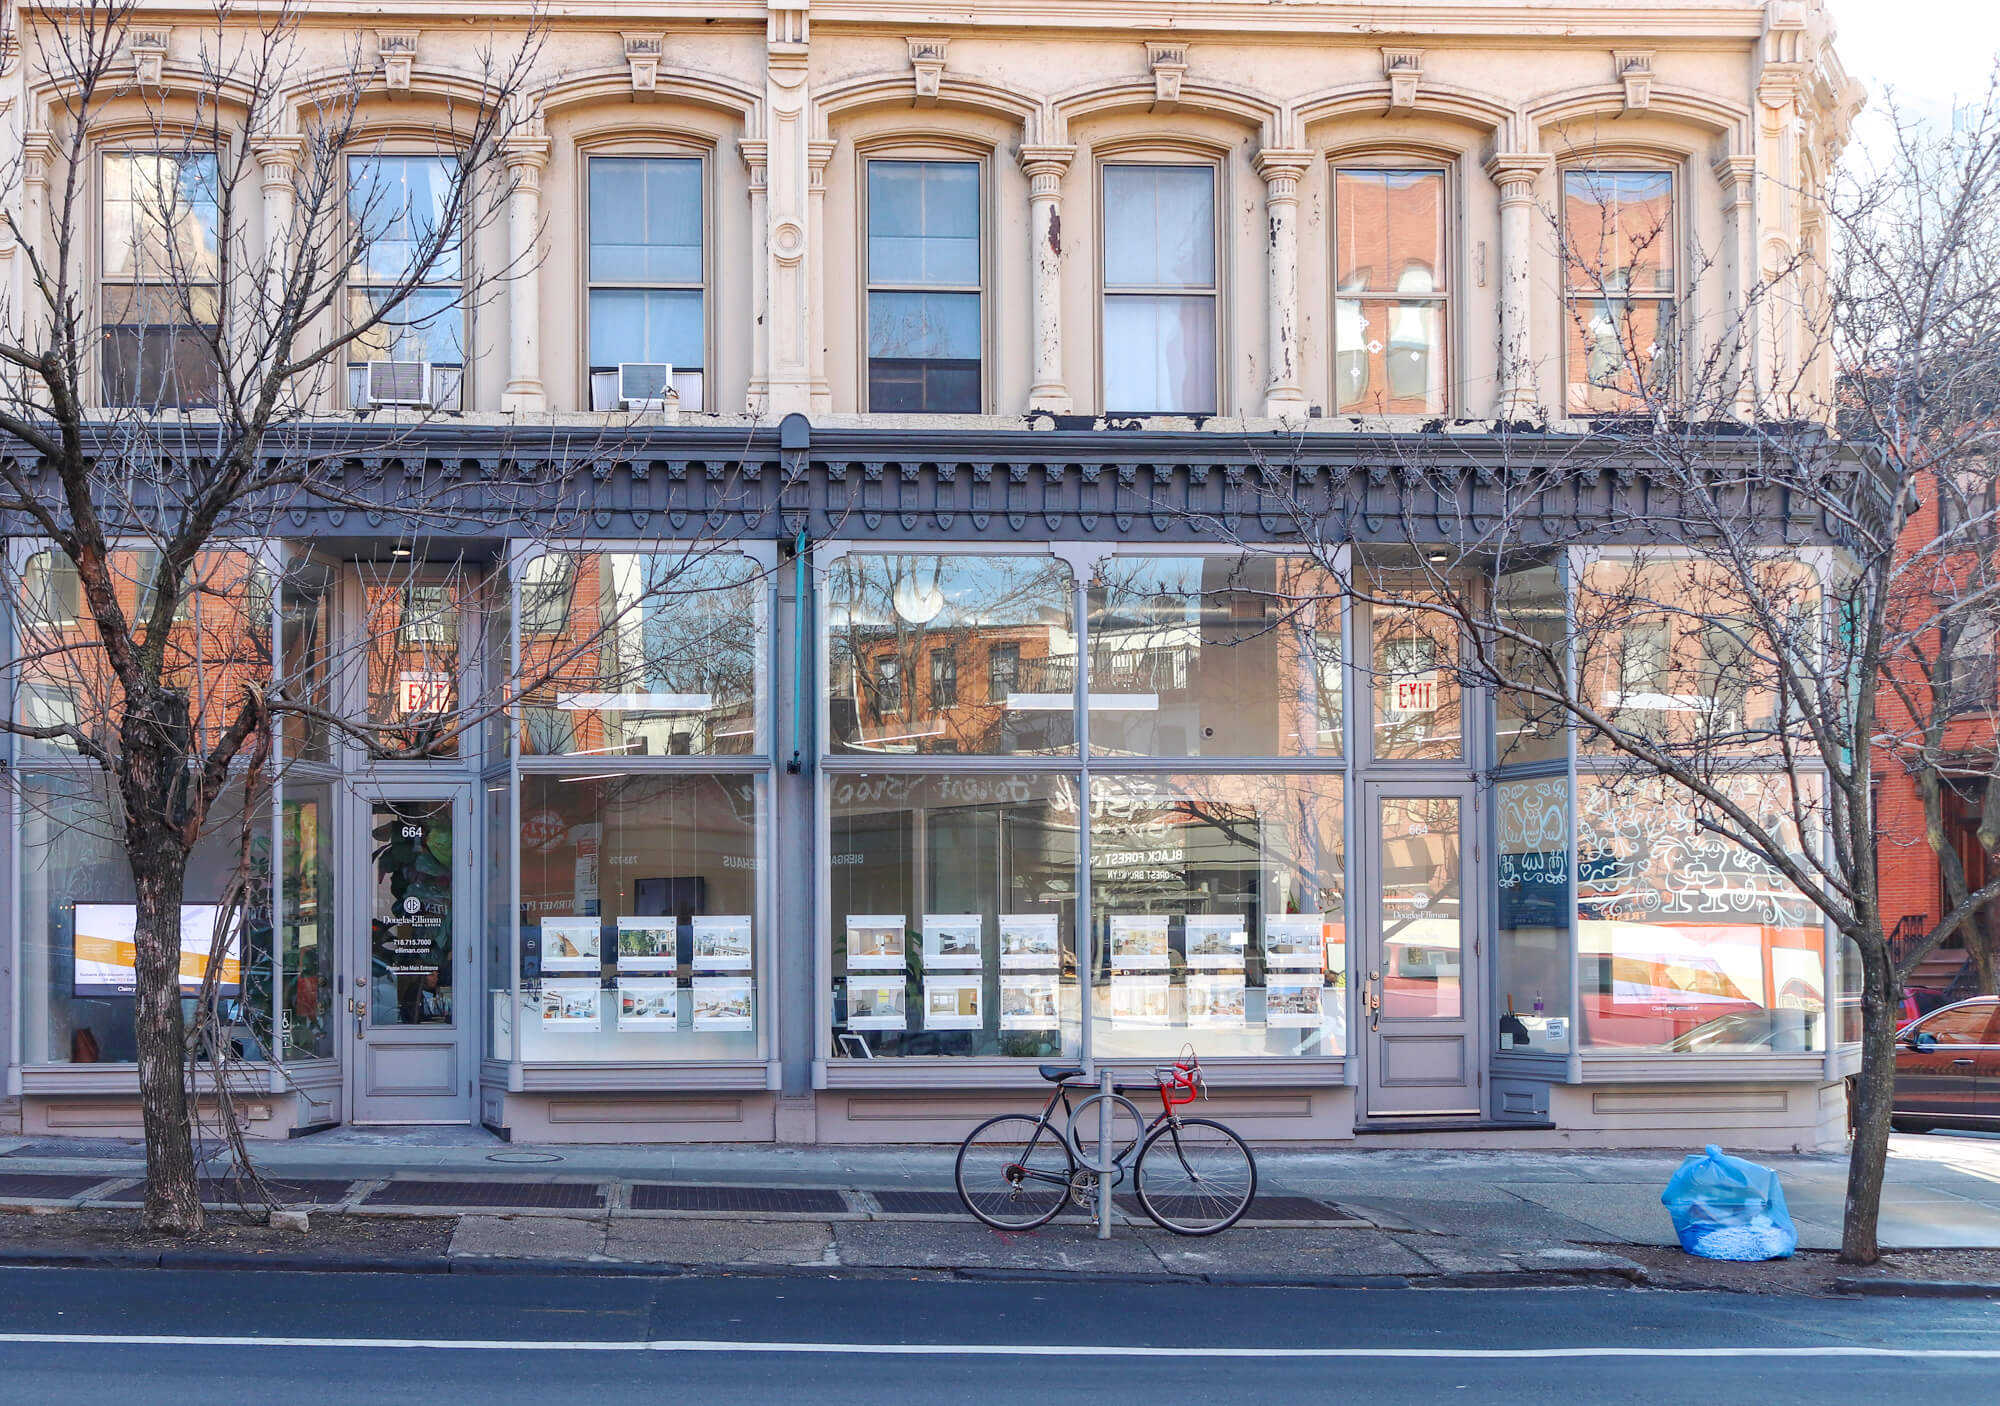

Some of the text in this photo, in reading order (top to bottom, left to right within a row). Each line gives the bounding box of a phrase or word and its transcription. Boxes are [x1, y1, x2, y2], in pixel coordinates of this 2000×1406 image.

[1399, 683, 1432, 709] EXIT
[401, 826, 422, 838] 664
[1408, 825, 1428, 835] 664
